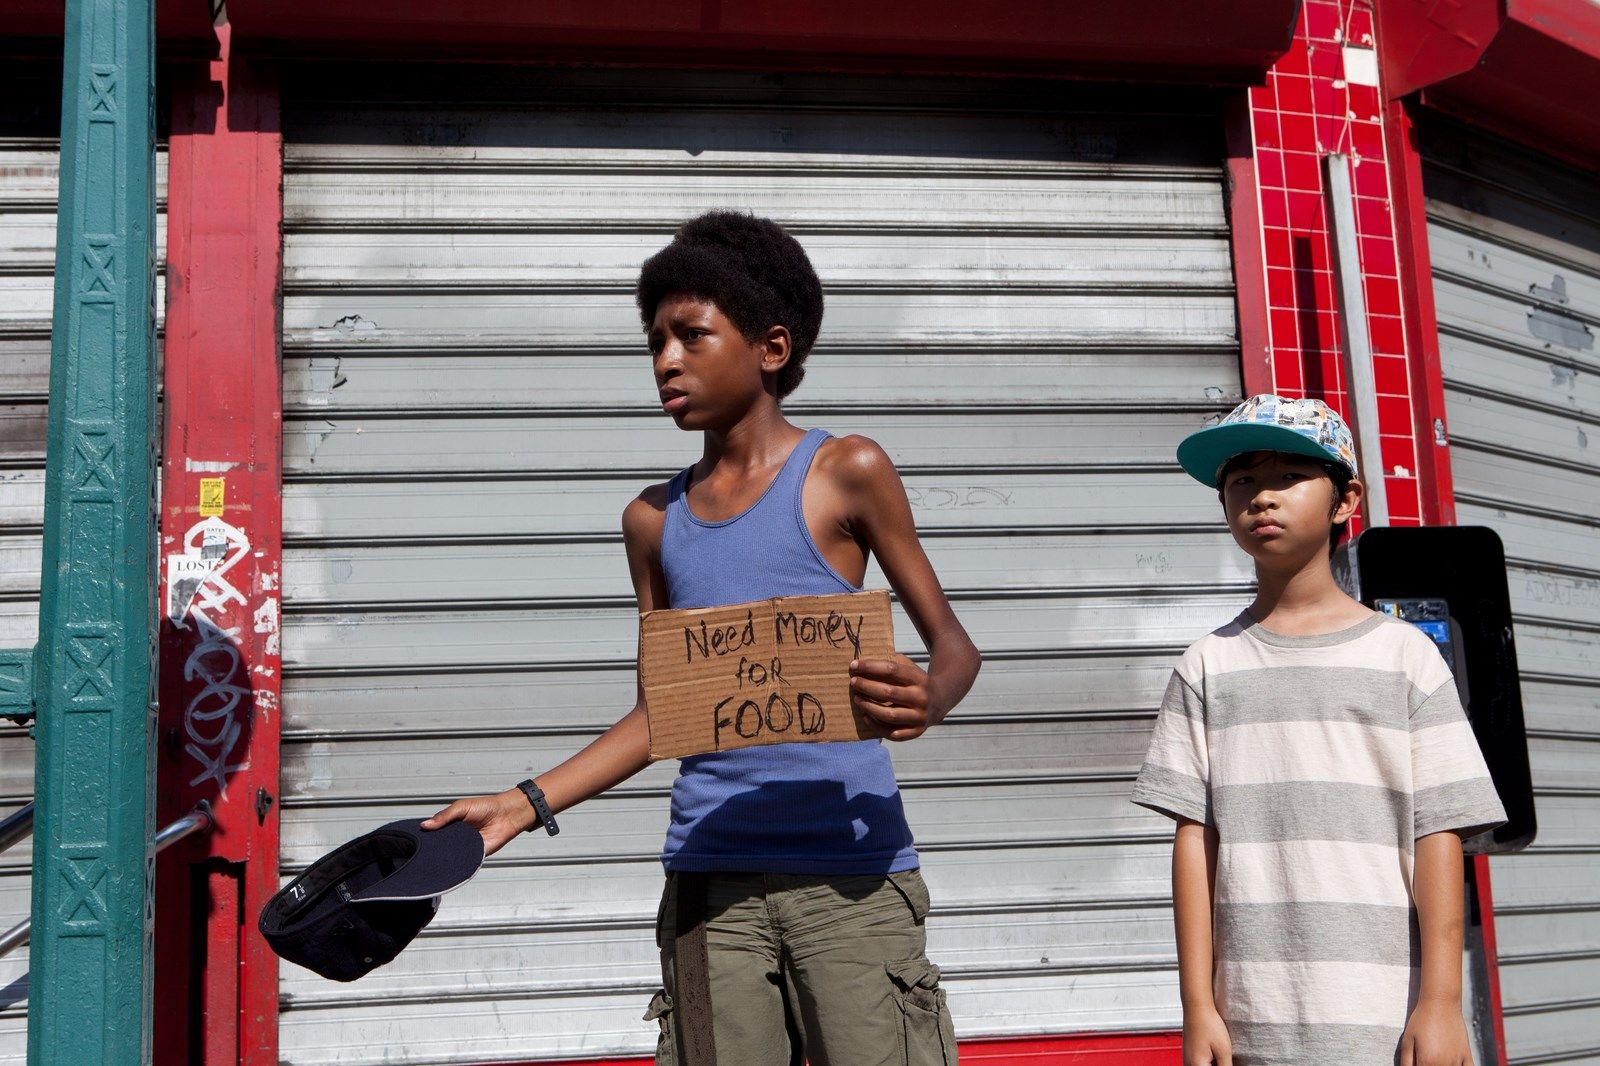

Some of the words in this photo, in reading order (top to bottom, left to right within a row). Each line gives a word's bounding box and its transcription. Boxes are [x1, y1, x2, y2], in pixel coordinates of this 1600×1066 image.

[177, 560, 214, 572] LOST
[684, 609, 756, 664] Need
[775, 609, 863, 660] Money
[713, 692, 825, 750] FOOD
